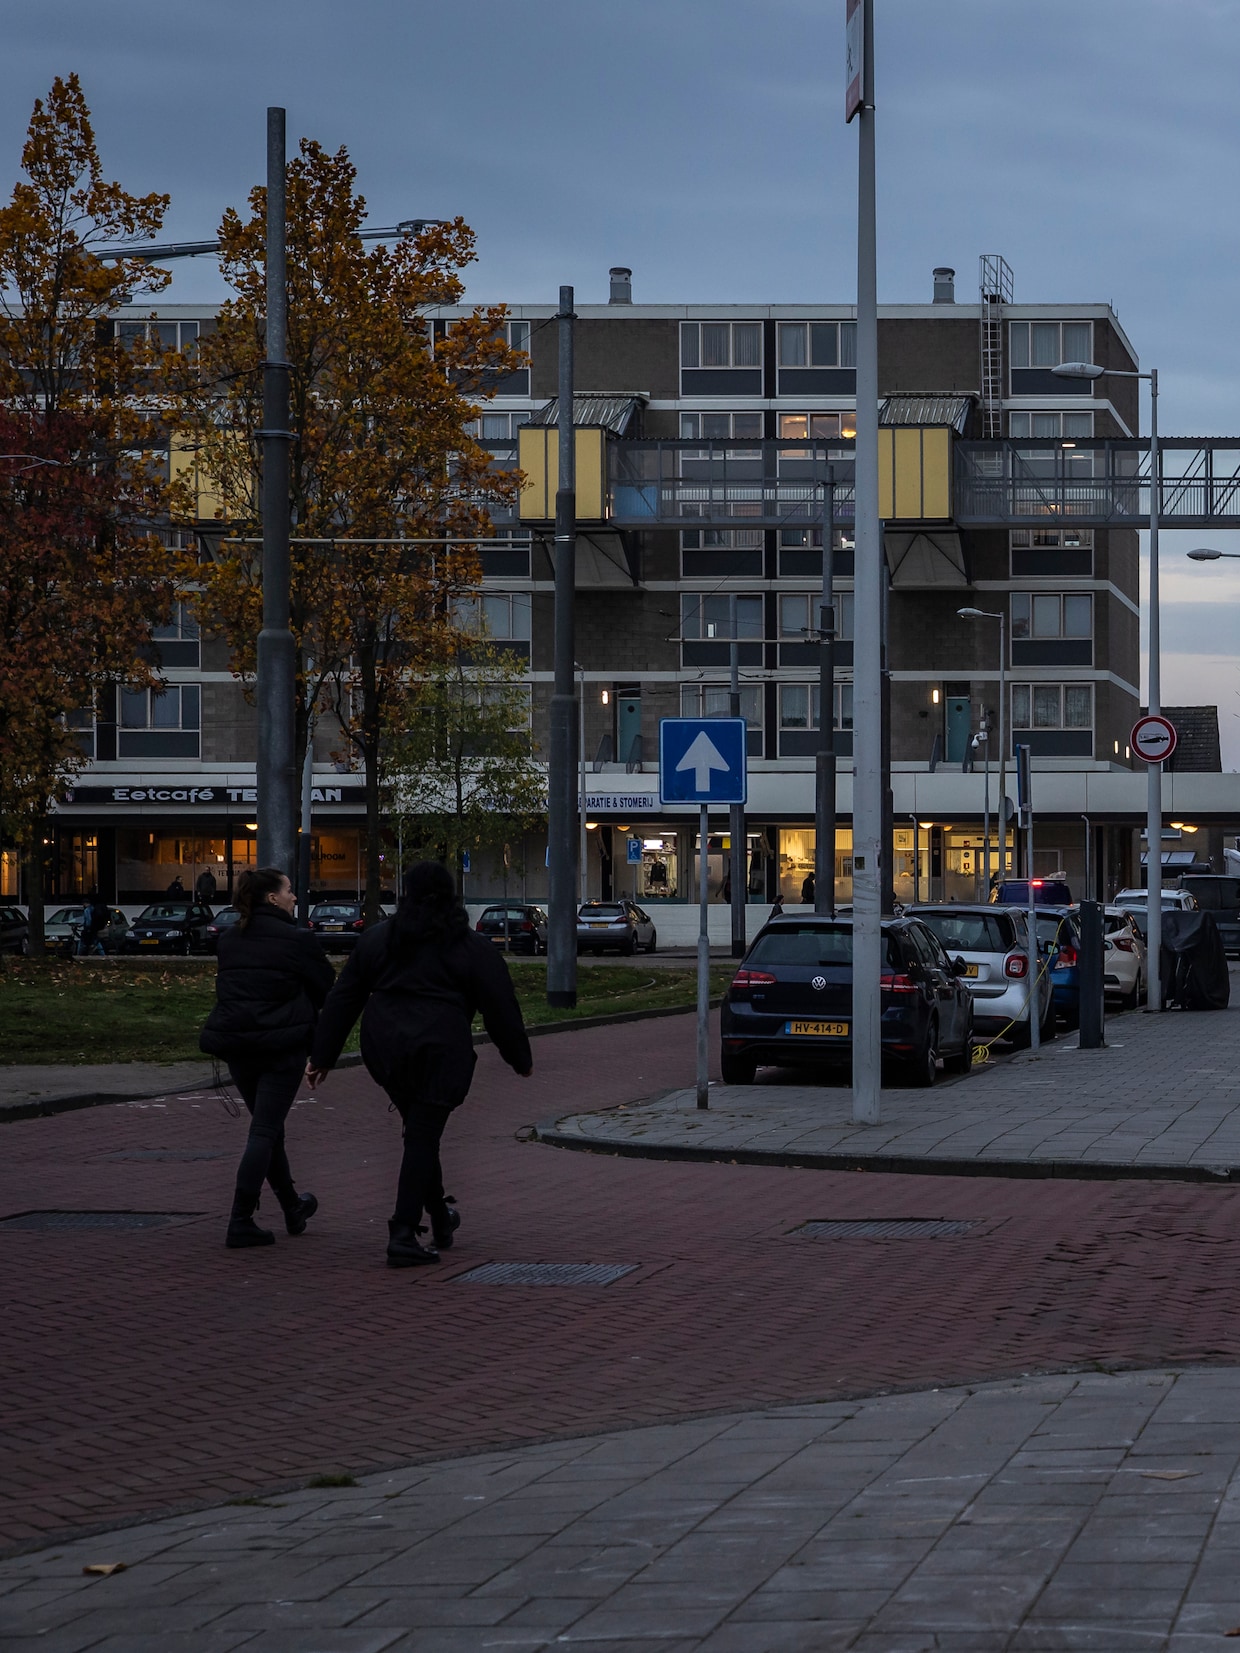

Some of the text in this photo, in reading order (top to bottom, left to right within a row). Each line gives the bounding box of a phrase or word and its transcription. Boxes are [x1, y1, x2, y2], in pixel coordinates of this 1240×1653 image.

[112, 787, 342, 803] Eetcafé TEAN
[612, 797, 618, 808] &
[619, 797, 654, 808] STOMERIJ
[794, 1023, 844, 1034] HV-414-D
